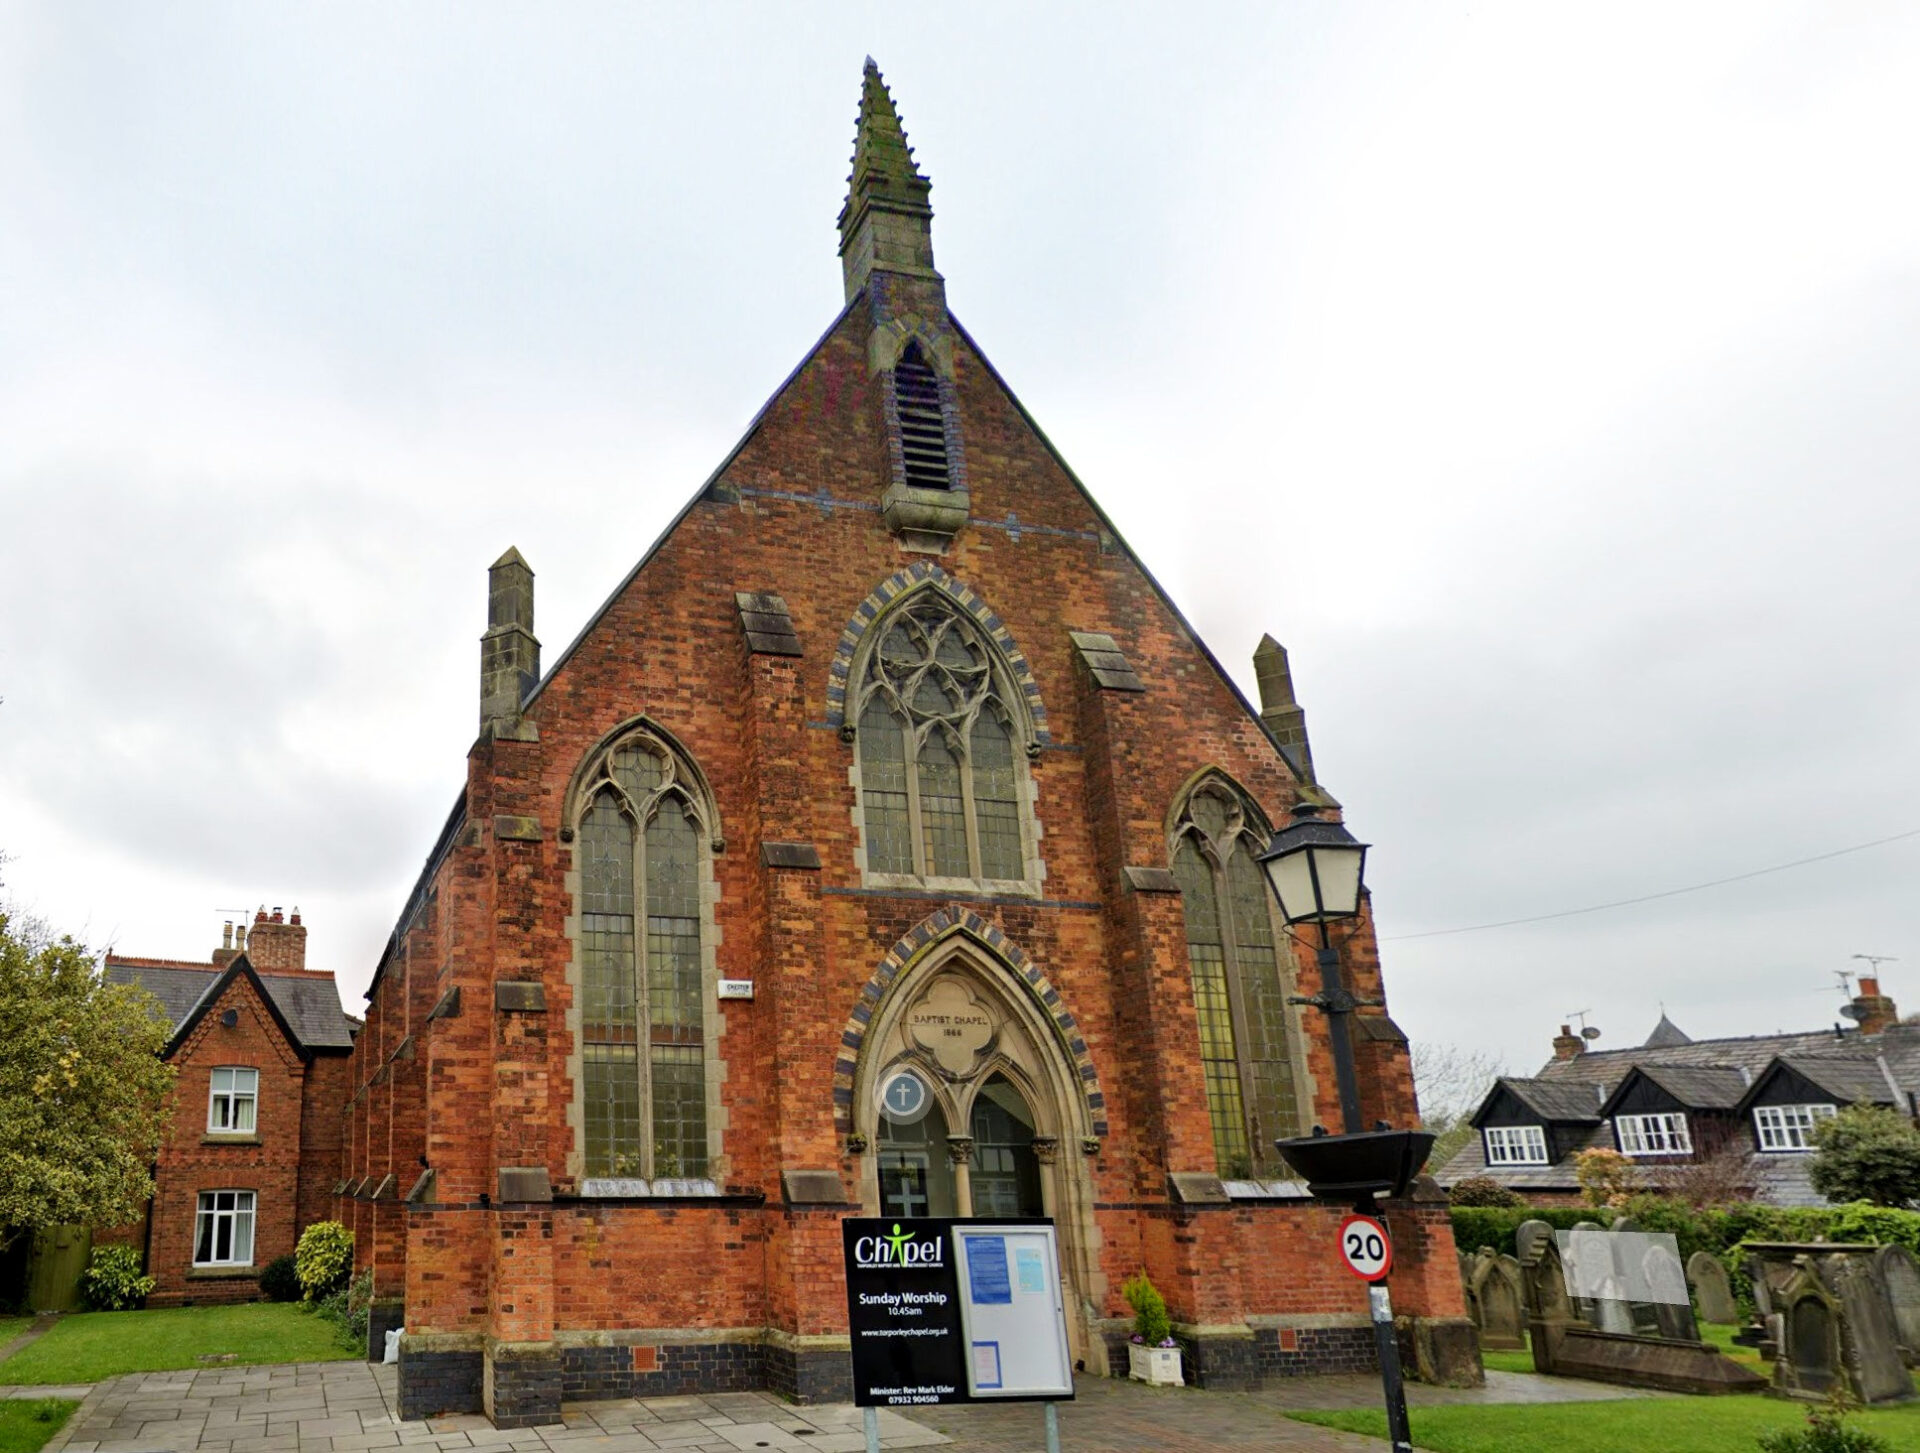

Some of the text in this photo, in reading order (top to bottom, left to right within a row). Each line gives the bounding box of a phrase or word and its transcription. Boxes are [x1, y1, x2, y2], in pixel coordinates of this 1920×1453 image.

[914, 1014, 988, 1025] BAPTIST CHAPEL
[1347, 1234, 1384, 1262] 20
[859, 1292, 947, 1306] Sunday Worship
[888, 1307, 922, 1315] 10.45am
[870, 1385, 955, 1395] Minister: Rev Mark Elder
[888, 1396, 911, 1404] 07932
